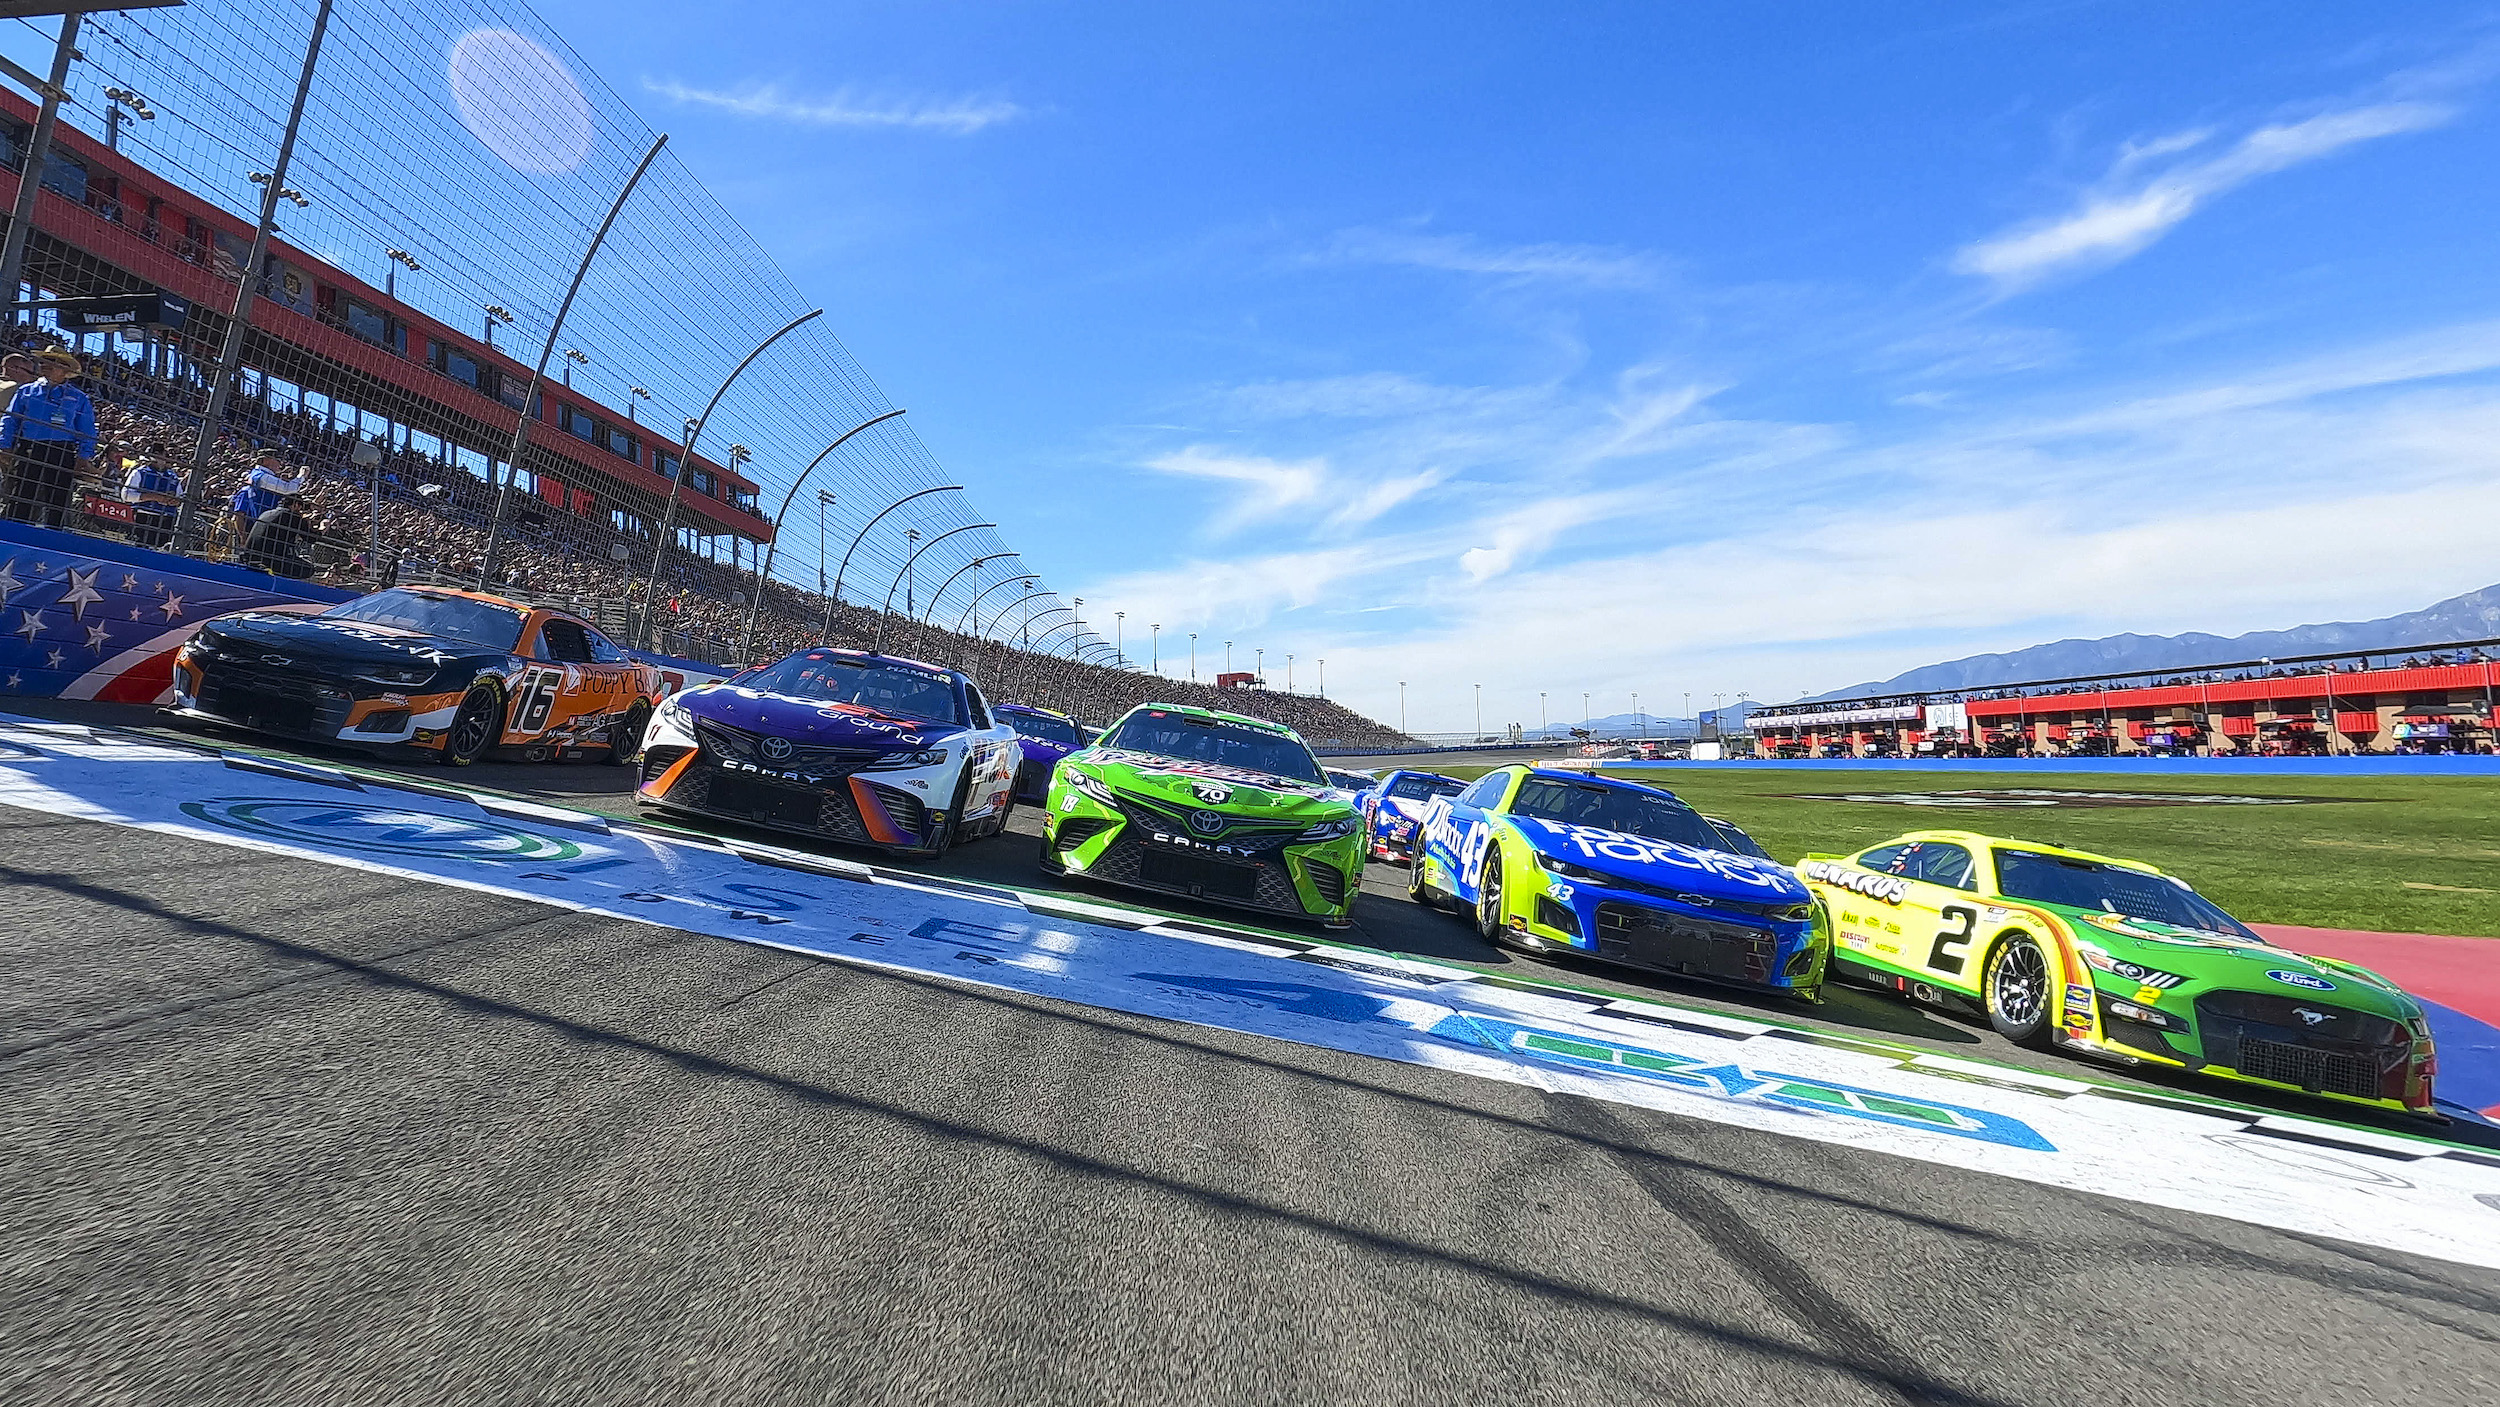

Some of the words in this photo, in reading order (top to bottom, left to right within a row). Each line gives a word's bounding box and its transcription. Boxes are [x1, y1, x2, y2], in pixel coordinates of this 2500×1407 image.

[83, 311, 136, 323] WHELEN
[581, 666, 630, 695] POPPY
[886, 665, 951, 685] HAMLIN
[508, 665, 564, 735] 16
[817, 708, 924, 746] Ground
[1217, 719, 1250, 731] KYLE
[1197, 786, 1226, 801] 70
[1461, 820, 1490, 889] 43
[1571, 831, 1788, 894] factor
[1547, 883, 1575, 901] 43
[1807, 861, 1914, 906] MENARDS
[1926, 905, 1978, 976] 2
[2280, 972, 2323, 988] Ford
[2133, 986, 2162, 1005] 2
